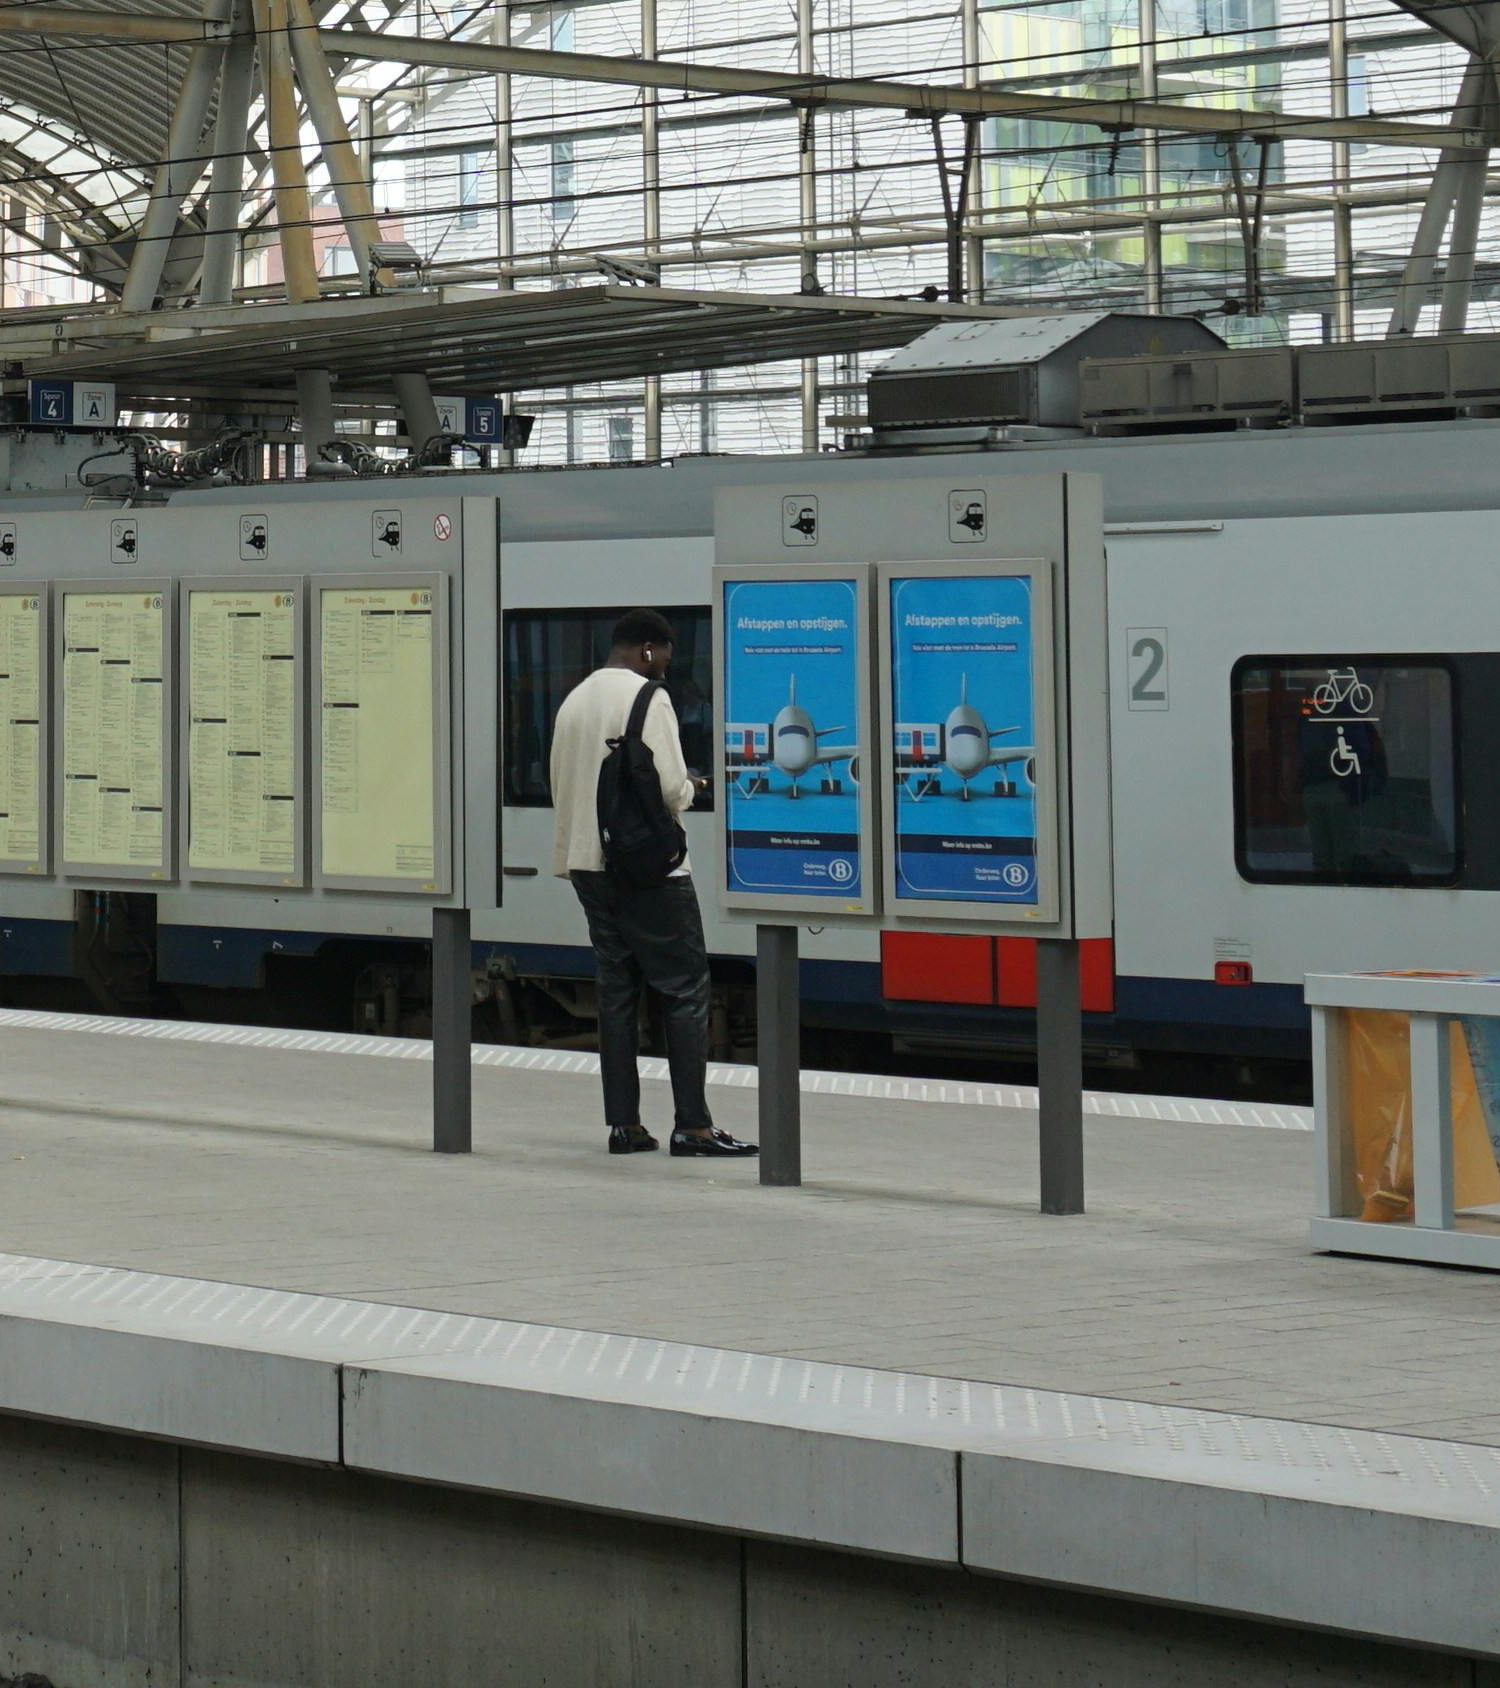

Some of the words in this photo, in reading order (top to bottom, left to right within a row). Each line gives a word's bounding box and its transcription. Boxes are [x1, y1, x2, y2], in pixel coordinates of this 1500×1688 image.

[47, 401, 57, 417] 4
[89, 401, 99, 417] A
[442, 415, 451, 430] A
[480, 417, 488, 432] 5
[737, 617, 784, 631] Afstappen
[786, 619, 798, 628] en
[800, 616, 848, 630] opstijgen.
[905, 614, 956, 628] Afstappen
[958, 616, 969, 625] en
[971, 613, 1022, 627] opstijgen.
[1132, 638, 1165, 701] 2
